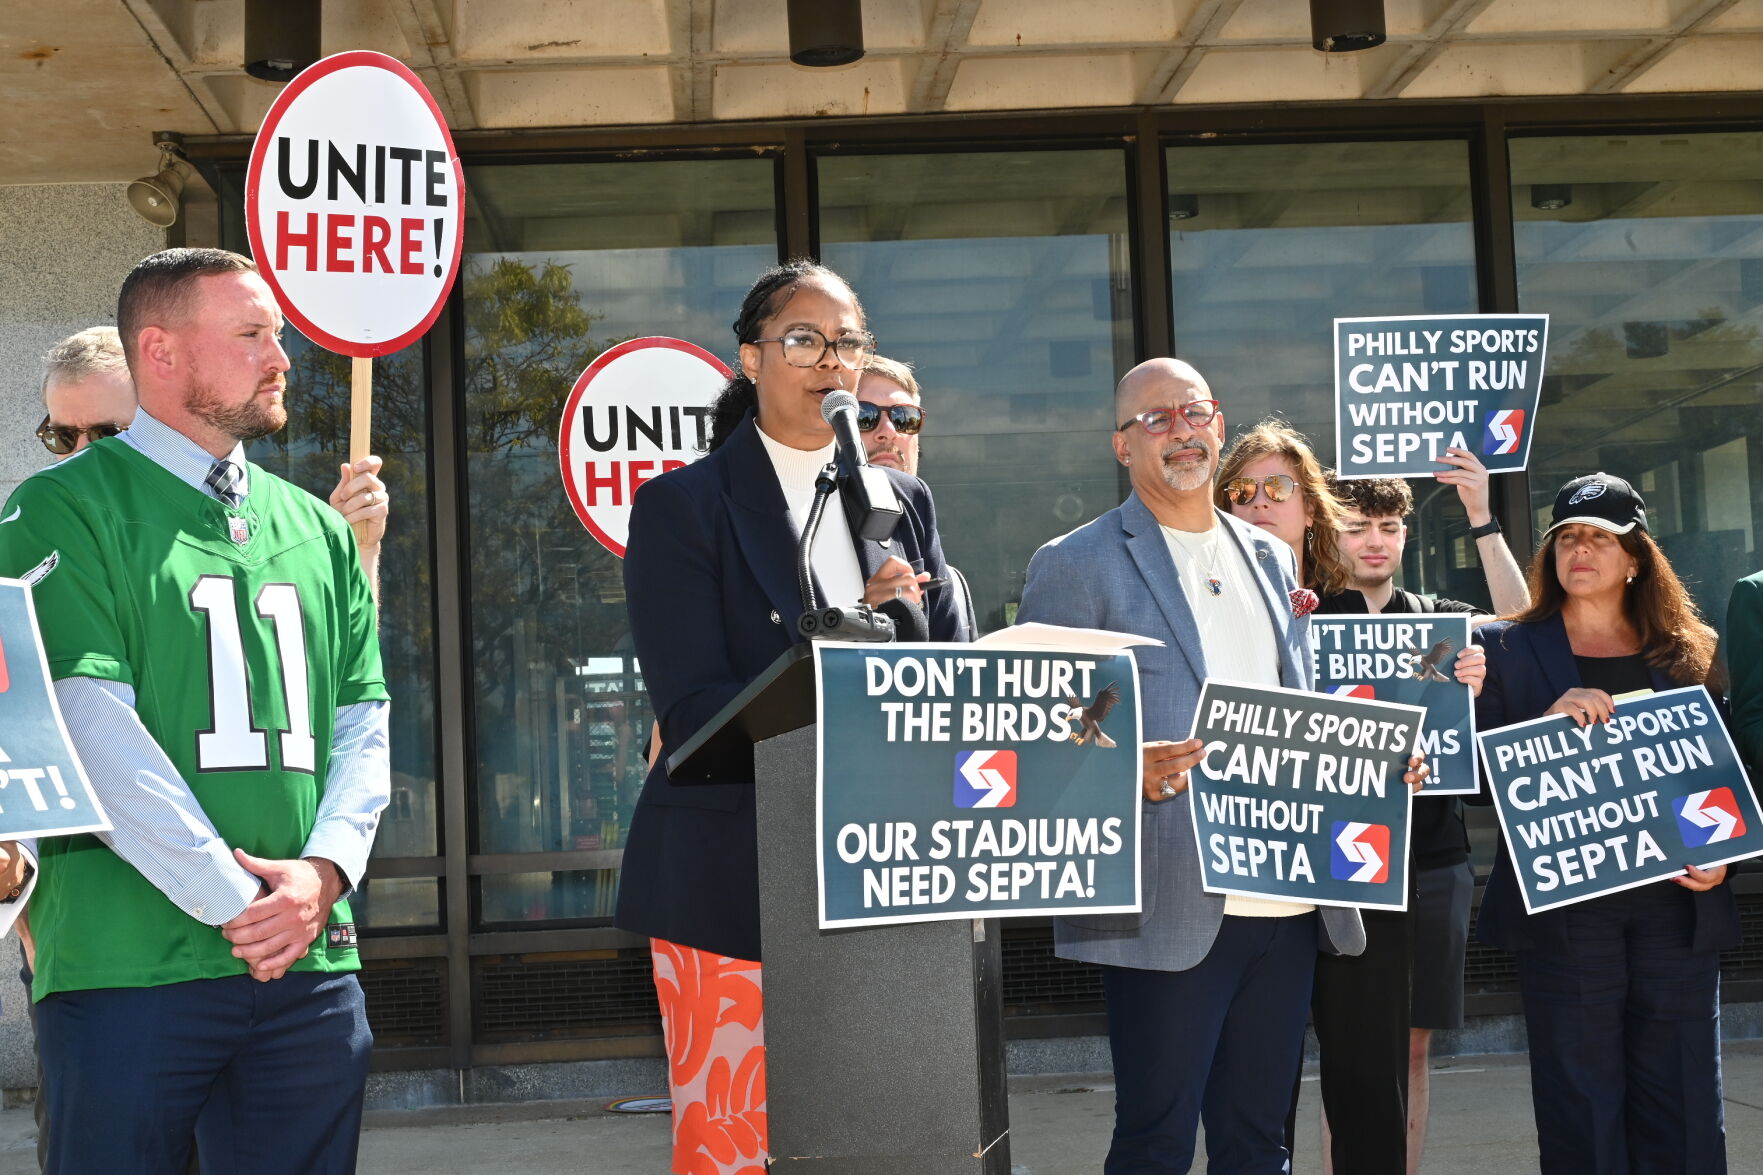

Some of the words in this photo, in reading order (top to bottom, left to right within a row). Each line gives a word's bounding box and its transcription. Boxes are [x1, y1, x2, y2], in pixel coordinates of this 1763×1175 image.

[278, 137, 447, 207] UNITE
[276, 211, 444, 278] HERE!
[1348, 331, 1443, 356] PHILLY
[1450, 329, 1538, 353] SPORTS
[1349, 361, 1459, 394] CAN'T
[1468, 360, 1527, 390] RUN
[582, 404, 714, 452] UNIT
[1348, 400, 1478, 427] WITHOUT
[1354, 623, 1433, 650] HURT
[188, 573, 315, 775] 11
[865, 656, 987, 697] DON'T
[997, 659, 1096, 698] HURT
[1329, 652, 1414, 680] BIRDS
[881, 703, 951, 742] THE
[962, 703, 1072, 742] BIRDS
[1206, 699, 1304, 739] PHILLY
[1304, 712, 1409, 753] SPORTS
[1495, 724, 1594, 772] PHILLY
[1603, 702, 1709, 745] SPORTS
[1200, 740, 1310, 789] CAN'T
[1315, 753, 1388, 798] RUN
[1507, 752, 1624, 811] CAN'T
[1632, 735, 1714, 781] RUN
[1200, 791, 1324, 834] WITHOUT
[1516, 790, 1660, 849] WITHOUT
[836, 822, 920, 863] OUR
[928, 817, 1122, 859] STADIUMS
[1209, 833, 1316, 884] SEPTA
[1532, 829, 1668, 892] SEPTA
[863, 865, 956, 908] NEED
[965, 859, 1096, 902] SEPTA!
